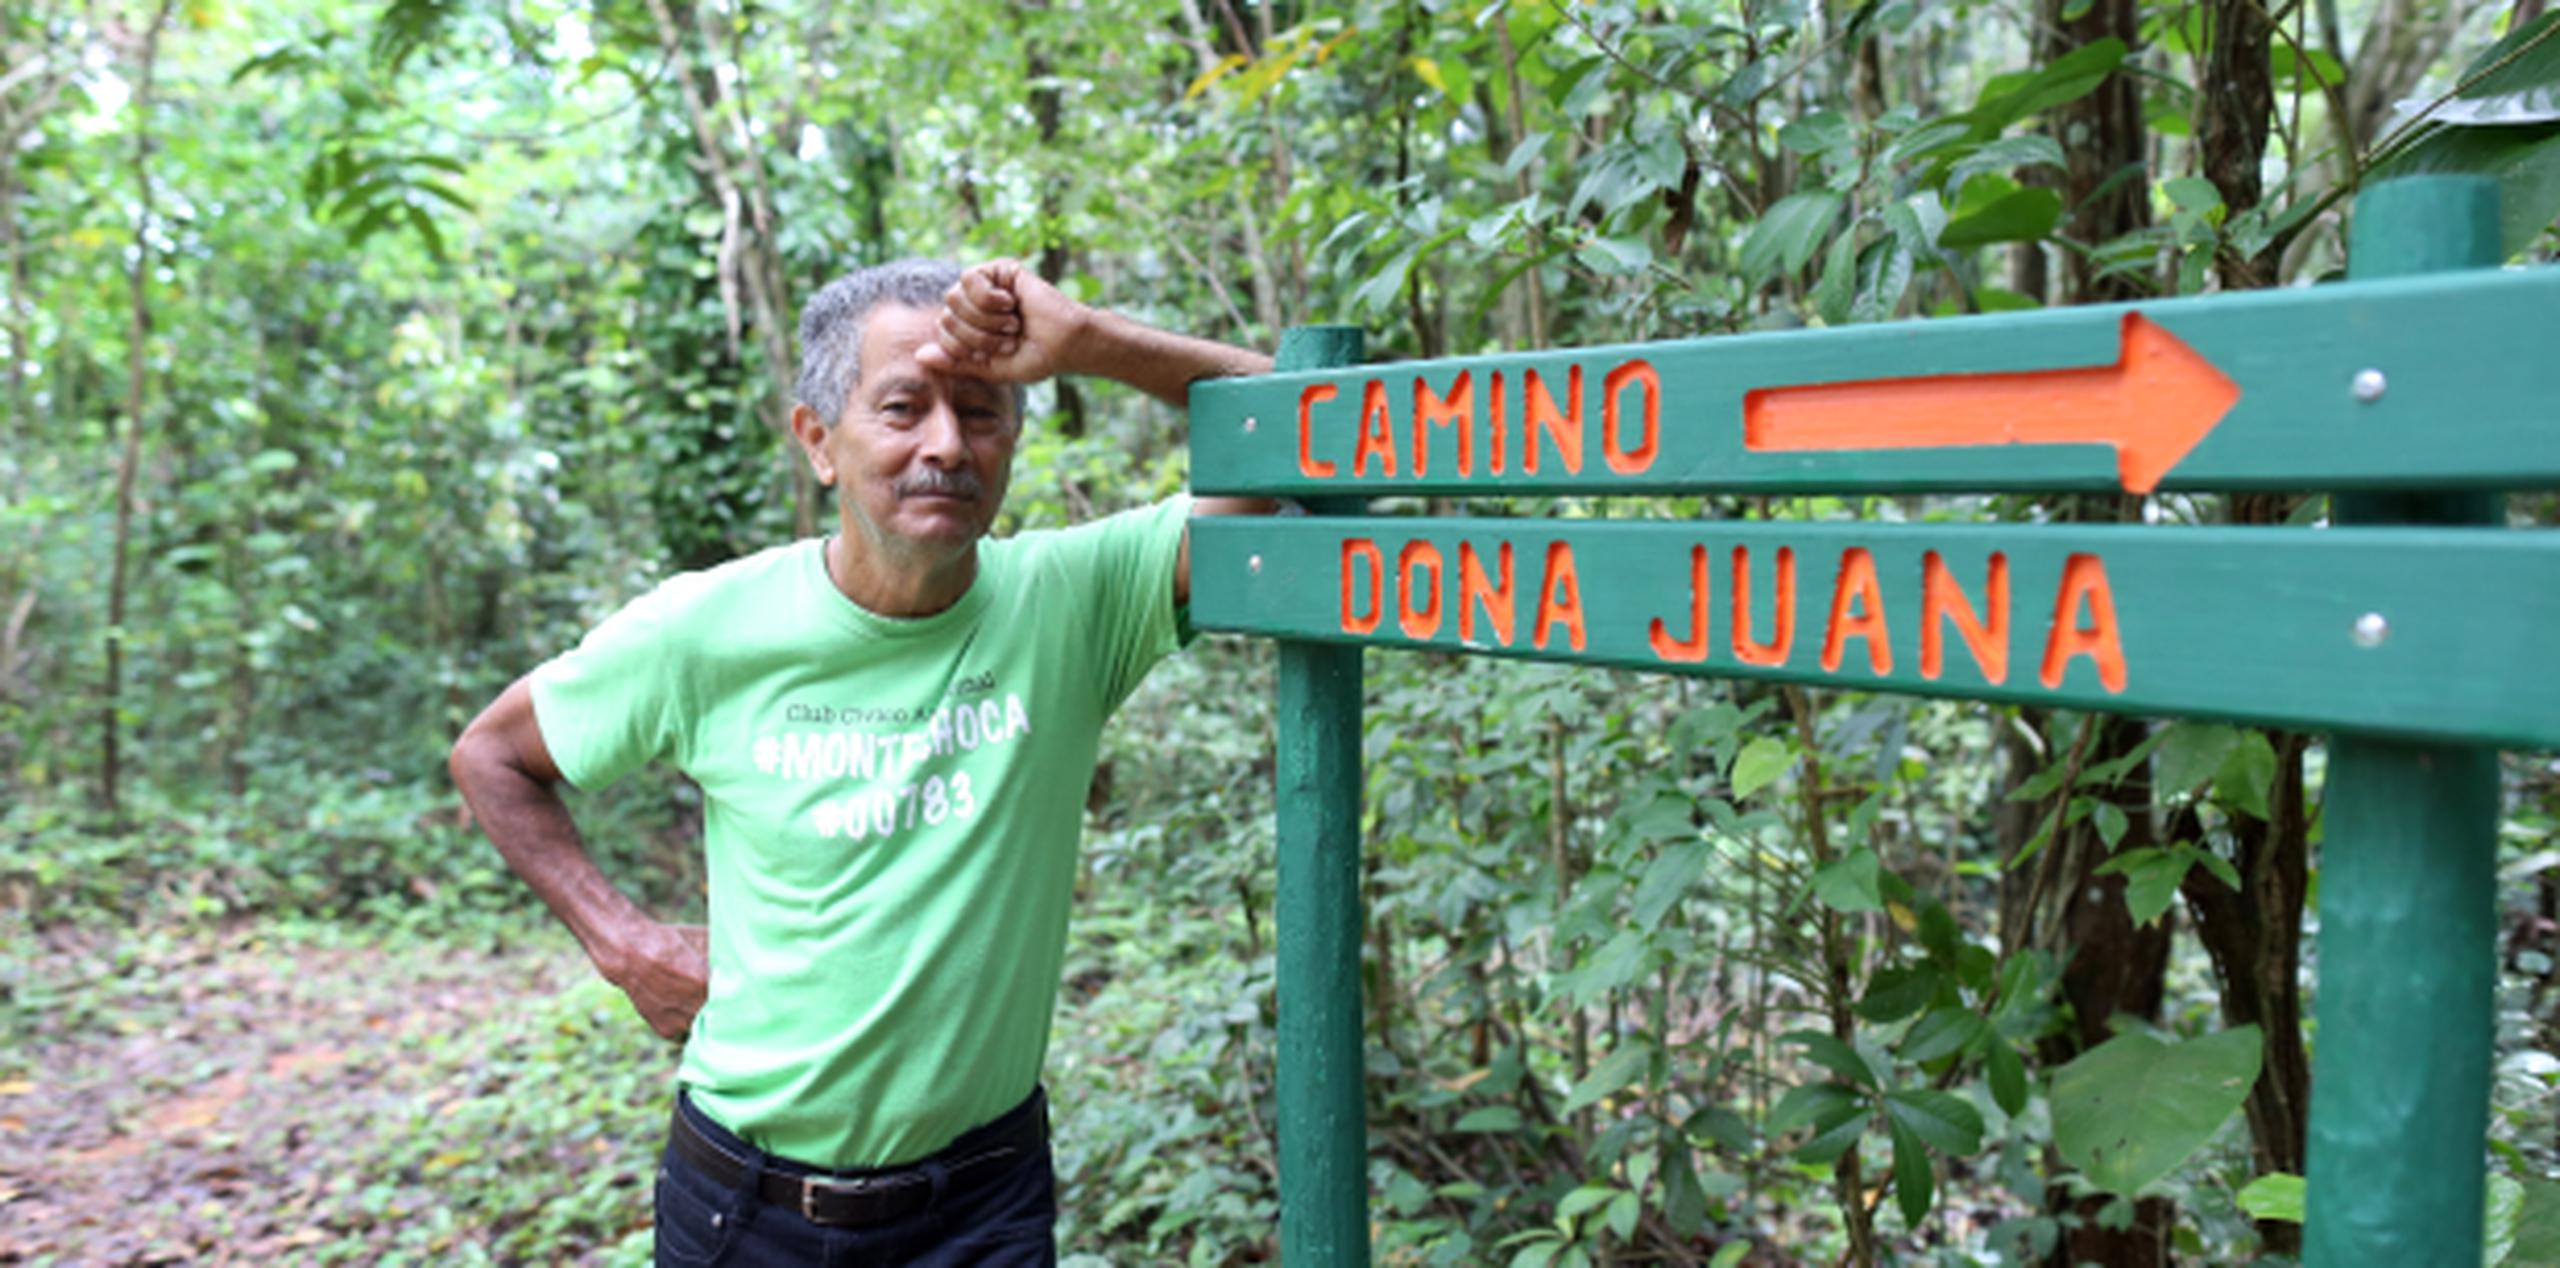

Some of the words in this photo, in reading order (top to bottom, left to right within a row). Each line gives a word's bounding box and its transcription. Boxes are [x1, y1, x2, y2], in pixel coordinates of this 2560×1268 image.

[1298, 358, 1661, 478] CAMINO
[1340, 538, 1586, 652] DONA
[1648, 544, 2128, 694] JUANA
[785, 703, 837, 724] Club
